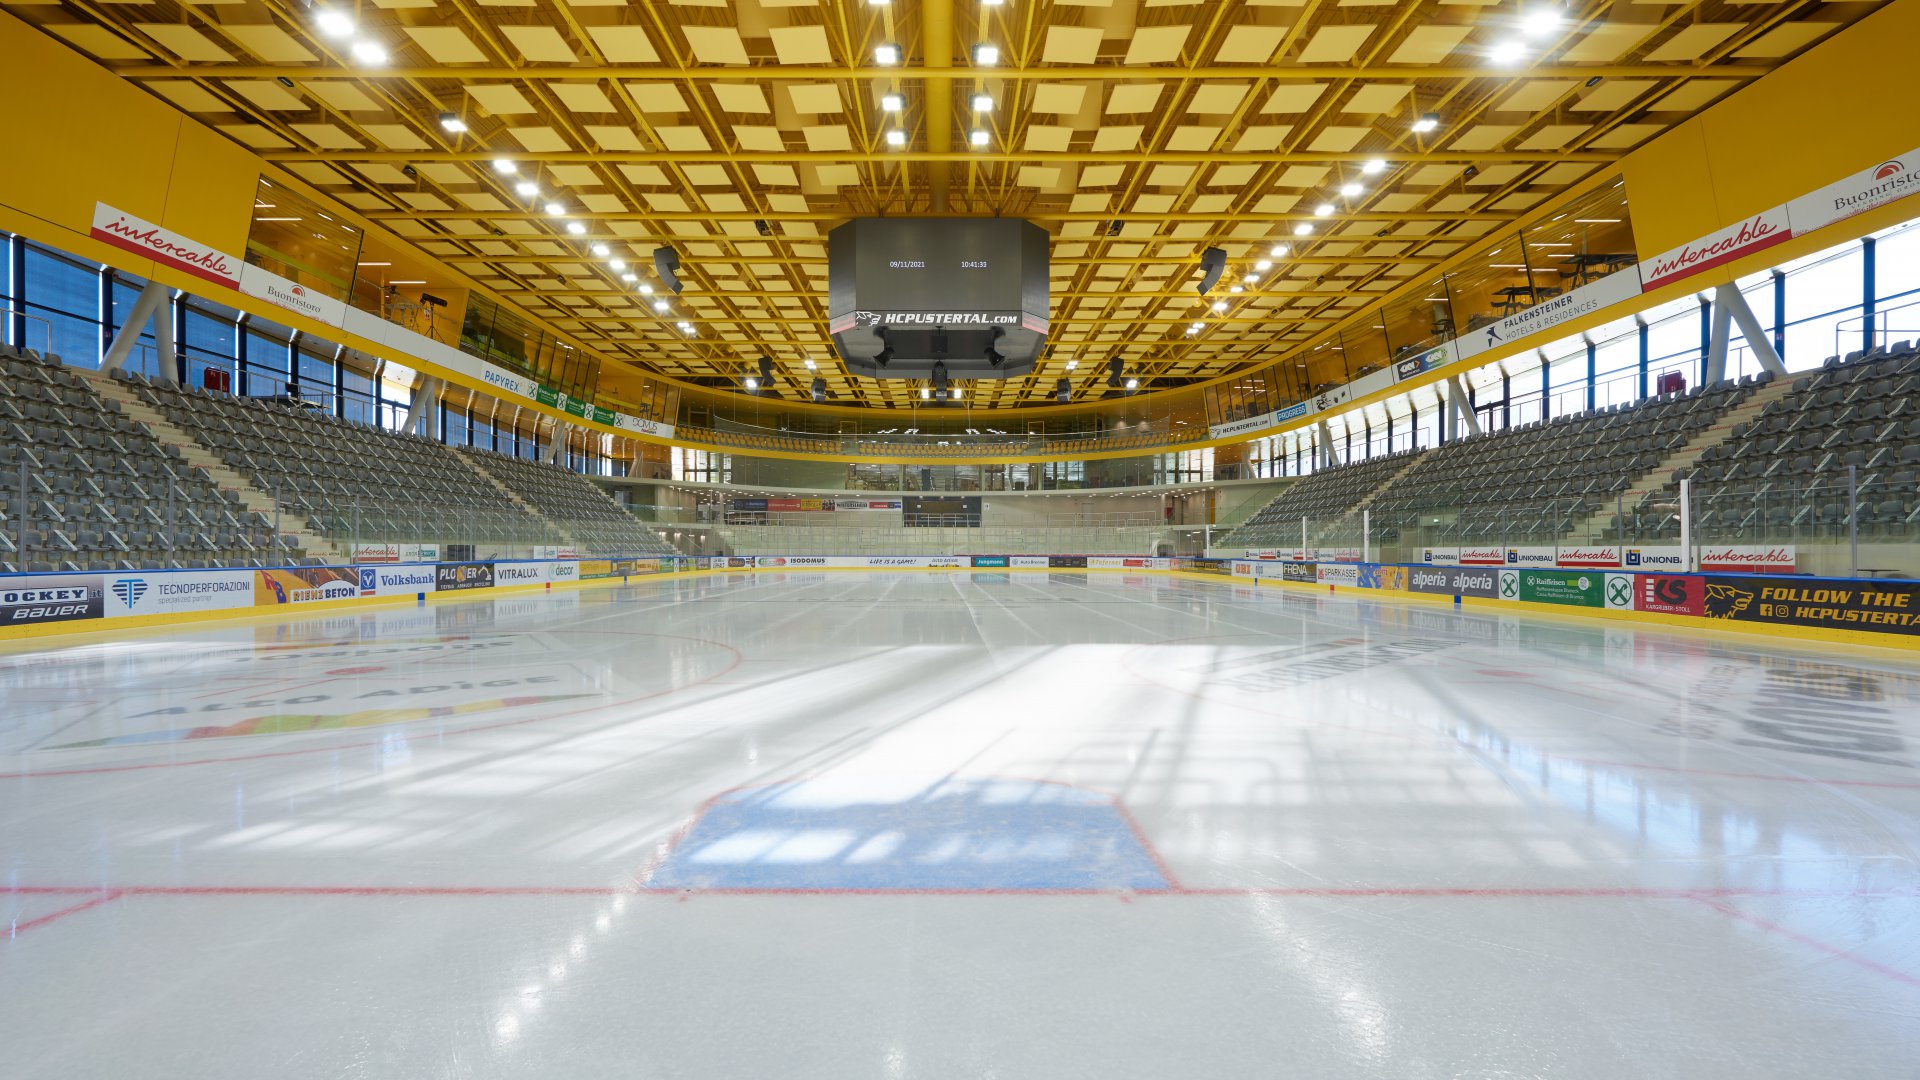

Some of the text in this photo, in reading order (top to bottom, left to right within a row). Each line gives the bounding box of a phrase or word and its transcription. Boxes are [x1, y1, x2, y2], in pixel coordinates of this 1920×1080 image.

[105, 216, 232, 276] intercable
[1651, 216, 1777, 279] intercable
[889, 260, 925, 268] 09/11/2021
[267, 285, 321, 313] Buonristoro
[1504, 295, 1573, 329] FALKENSTEINER
[1506, 325, 1534, 340] HOTELS
[1544, 299, 1598, 325] RESIDENCES
[484, 370, 519, 393] PAPYREX
[1278, 405, 1306, 421] PROGRESS
[1462, 549, 1502, 559] intercable
[1518, 554, 1553, 562] UNIONBAU
[1559, 549, 1617, 560] intercable
[1703, 549, 1793, 562] intercable
[498, 567, 539, 580] VITRALUX
[555, 566, 574, 577] decor
[1283, 564, 1307, 575] FRENA
[1324, 568, 1356, 578] SPARKASSE
[381, 573, 434, 586] Volksbank
[1412, 571, 1492, 592] alperia alperia
[1536, 578, 1565, 586] Raiffeisen
[158, 581, 250, 595] TECNOPERFORAZIONI
[158, 596, 190, 605] specialized
[1760, 587, 1911, 607] FOLLOW THE
